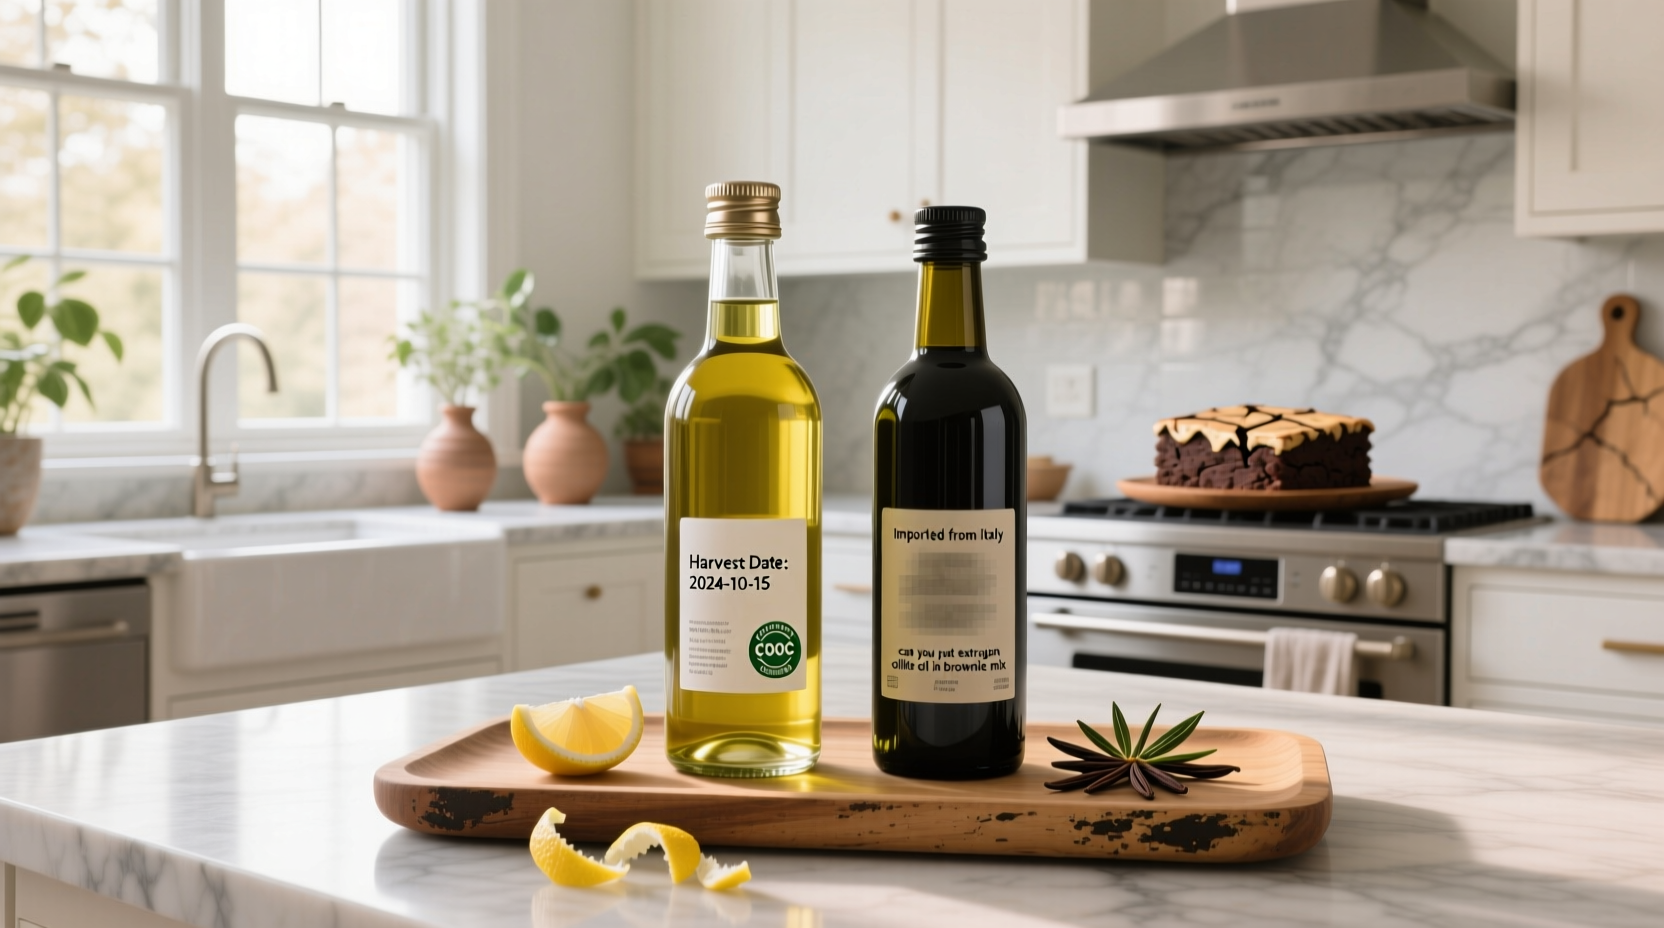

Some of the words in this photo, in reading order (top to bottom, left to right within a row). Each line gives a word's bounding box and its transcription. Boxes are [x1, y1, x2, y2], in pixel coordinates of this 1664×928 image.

[894, 528, 944, 543] Imported
[949, 527, 977, 541] from
[981, 528, 1003, 543] Italy
[690, 554, 745, 569] Harvest
[749, 555, 788, 570] Date:
[690, 576, 770, 590] 2024-10-15
[755, 641, 794, 657] COOC
